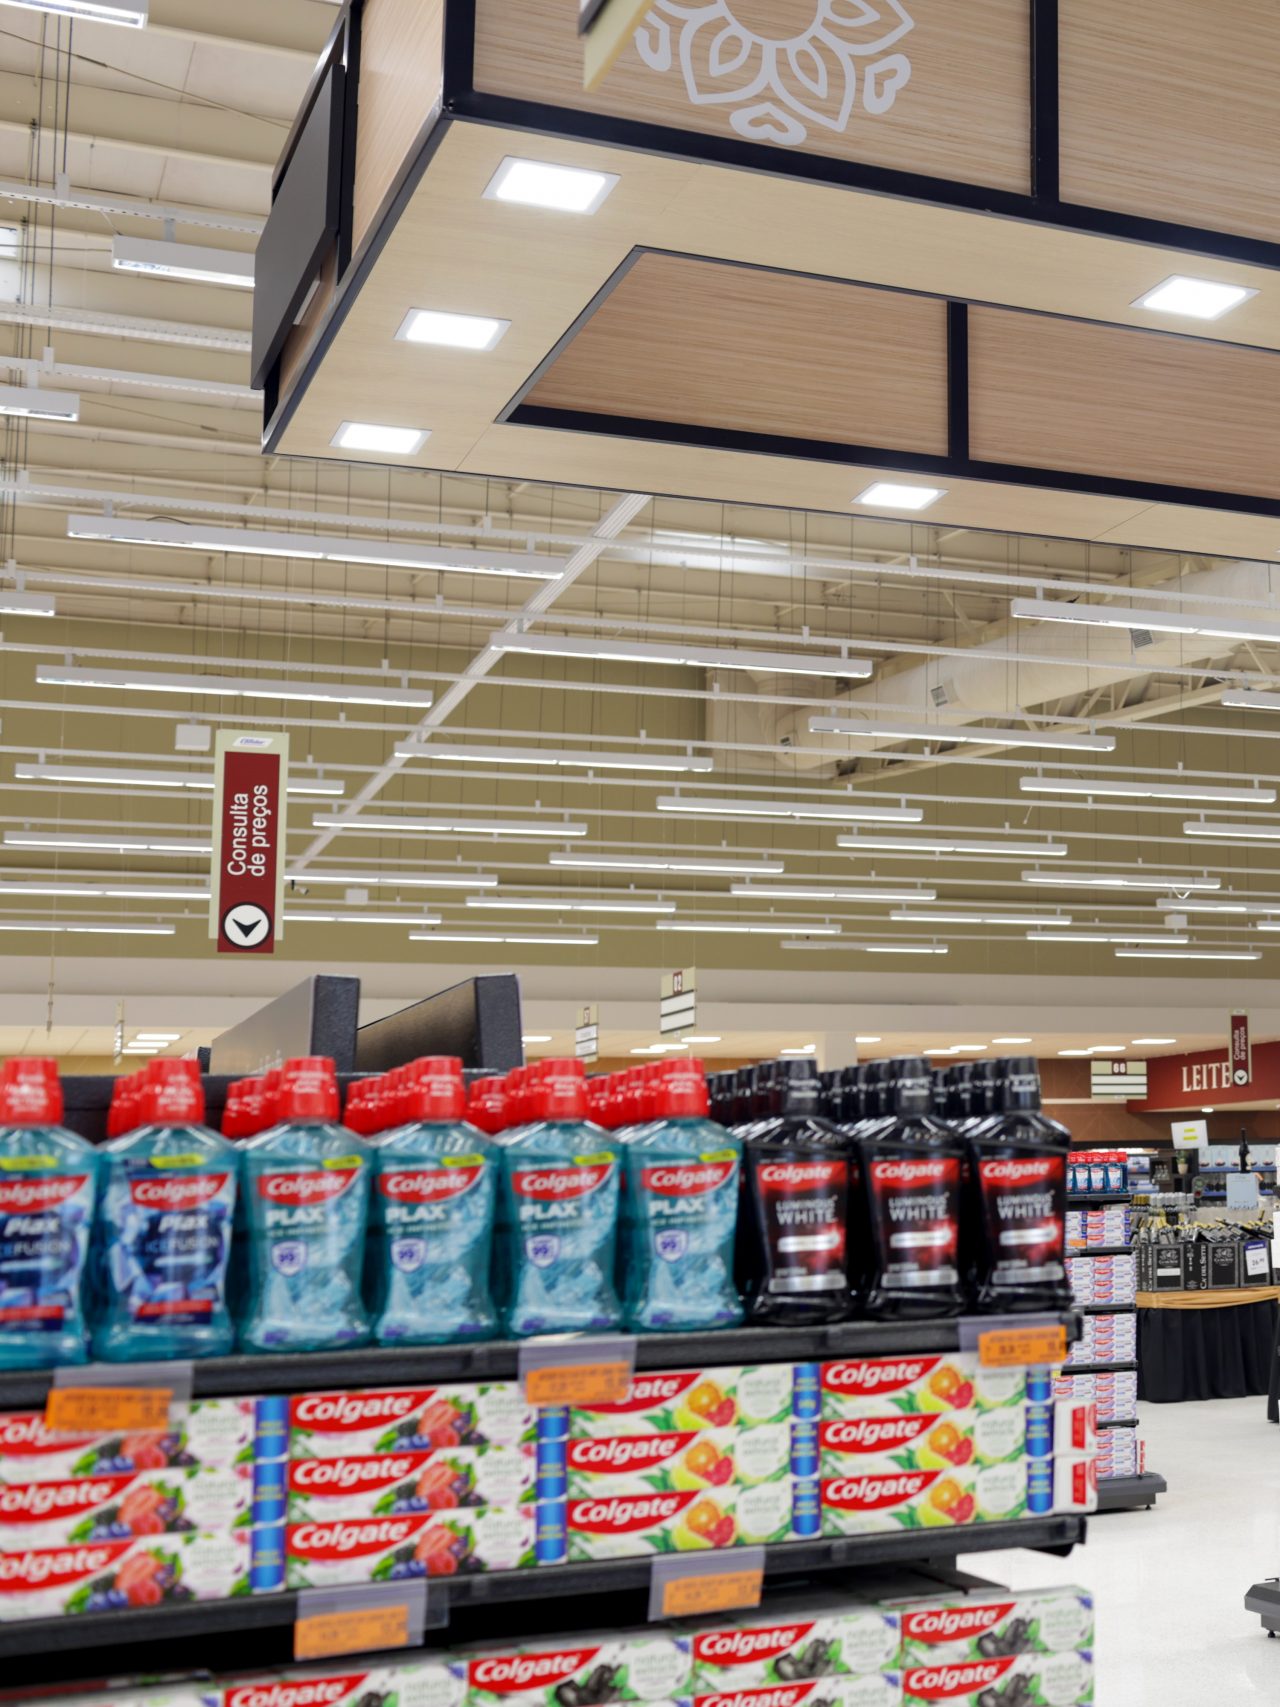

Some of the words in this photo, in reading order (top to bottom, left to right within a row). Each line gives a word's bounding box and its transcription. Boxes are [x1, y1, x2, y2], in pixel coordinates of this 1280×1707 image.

[253, 785, 271, 847] preços
[227, 793, 249, 876] Consulta
[247, 856, 266, 877] de
[650, 1168, 725, 1190] Colgate
[761, 1163, 833, 1183] Colgate
[875, 1162, 945, 1180] Colgate
[982, 1162, 1050, 1179] Colgate
[0, 1178, 74, 1202] olgate
[134, 1176, 220, 1202] Colgate
[266, 1175, 347, 1198] Colgate
[386, 1173, 469, 1195] Colgate
[521, 1171, 600, 1194] Colgate
[265, 1207, 325, 1227] PLAX
[385, 1206, 446, 1224] PLAX
[520, 1204, 579, 1221] PLAX
[650, 1201, 706, 1217] PLAX
[776, 1210, 835, 1225] WHITE
[889, 1208, 946, 1222] WHITE
[998, 1206, 1053, 1219] WHITE
[5, 1216, 59, 1237] Plax
[159, 1215, 208, 1234] Plax
[825, 1358, 926, 1389] Colgate
[296, 1395, 413, 1428] Colgate
[825, 1415, 925, 1447] Colgate
[573, 1436, 679, 1468] Colgate
[293, 1456, 411, 1489] Colgate
[826, 1472, 926, 1505] Colgate
[572, 1494, 679, 1527] Colgate
[291, 1519, 409, 1556] Colgate
[909, 1608, 998, 1635] Colgate
[700, 1627, 800, 1657] Colgate
[474, 1652, 579, 1684] Colgate
[908, 1664, 999, 1690] Colgate
[231, 1681, 346, 1707] Colgate
